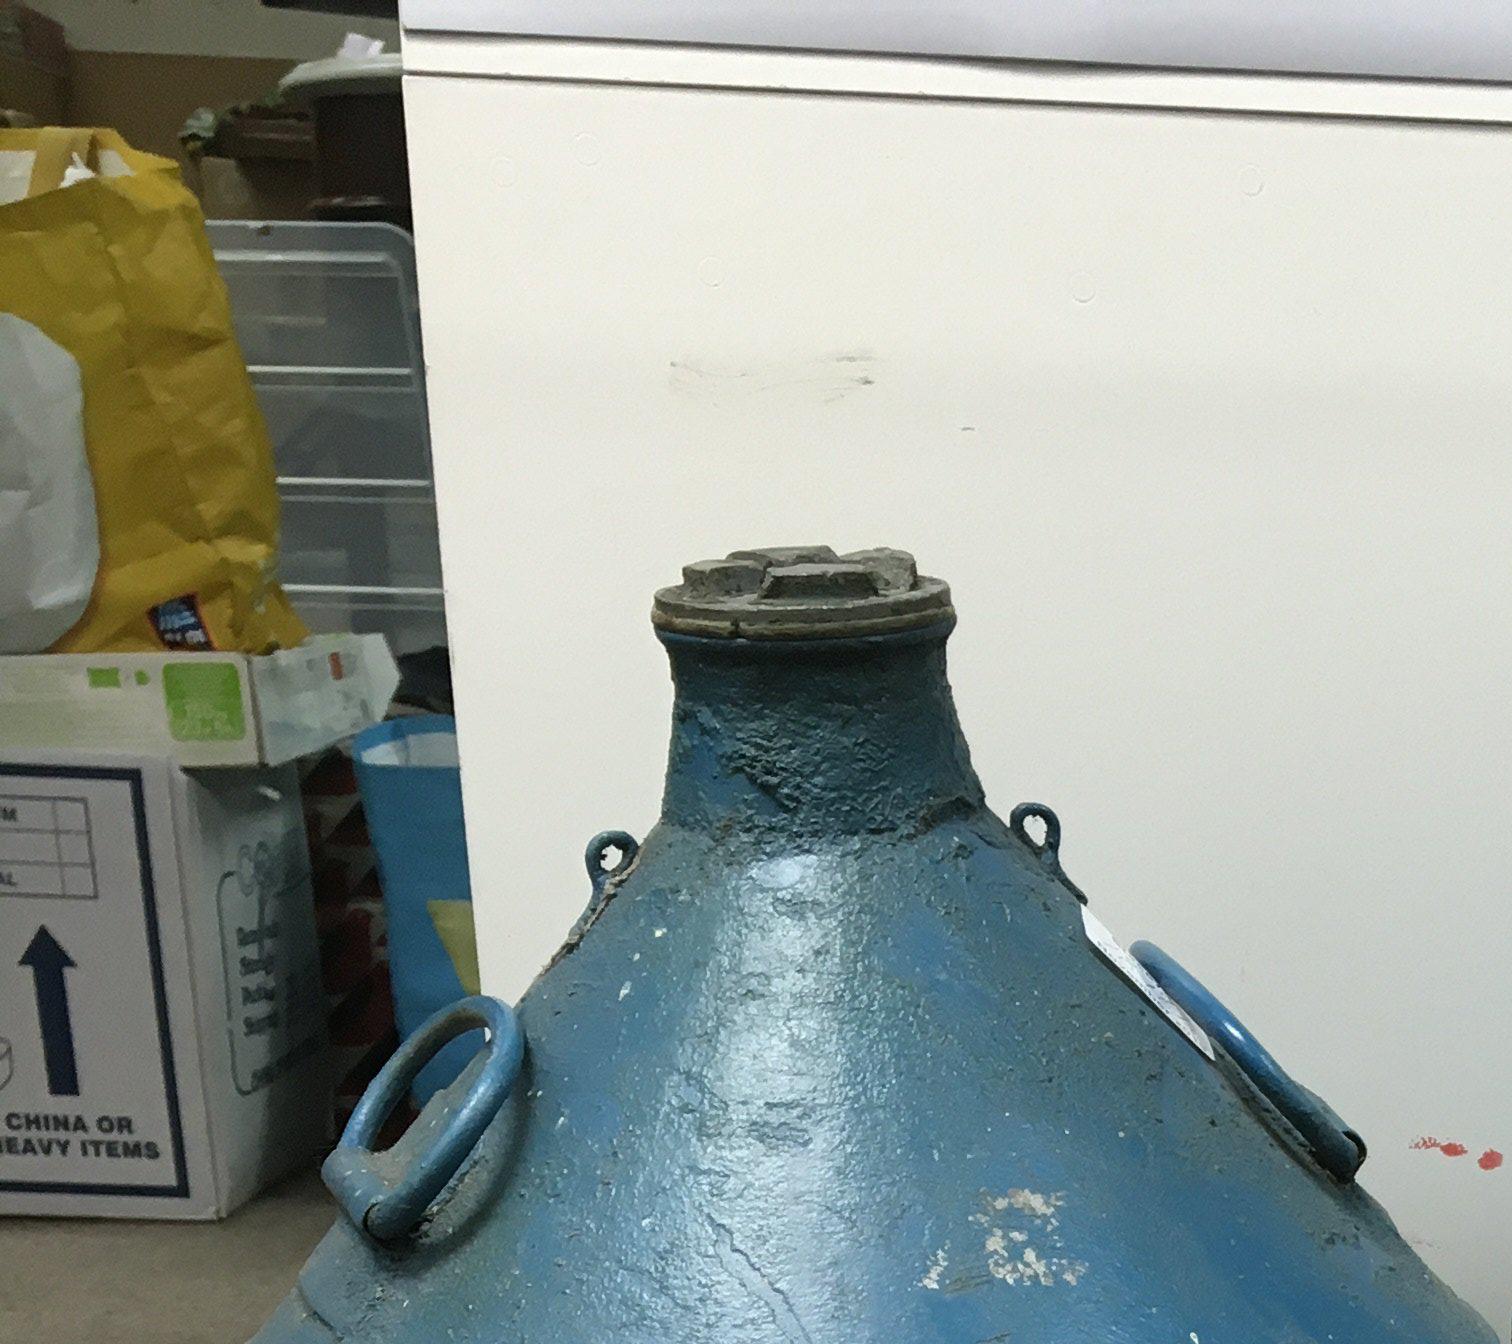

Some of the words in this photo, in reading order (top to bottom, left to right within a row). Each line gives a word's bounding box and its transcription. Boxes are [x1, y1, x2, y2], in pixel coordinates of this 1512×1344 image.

[5, 1112, 88, 1134] CHINA
[96, 1115, 134, 1135] OR
[80, 1140, 161, 1160] ITEMS
